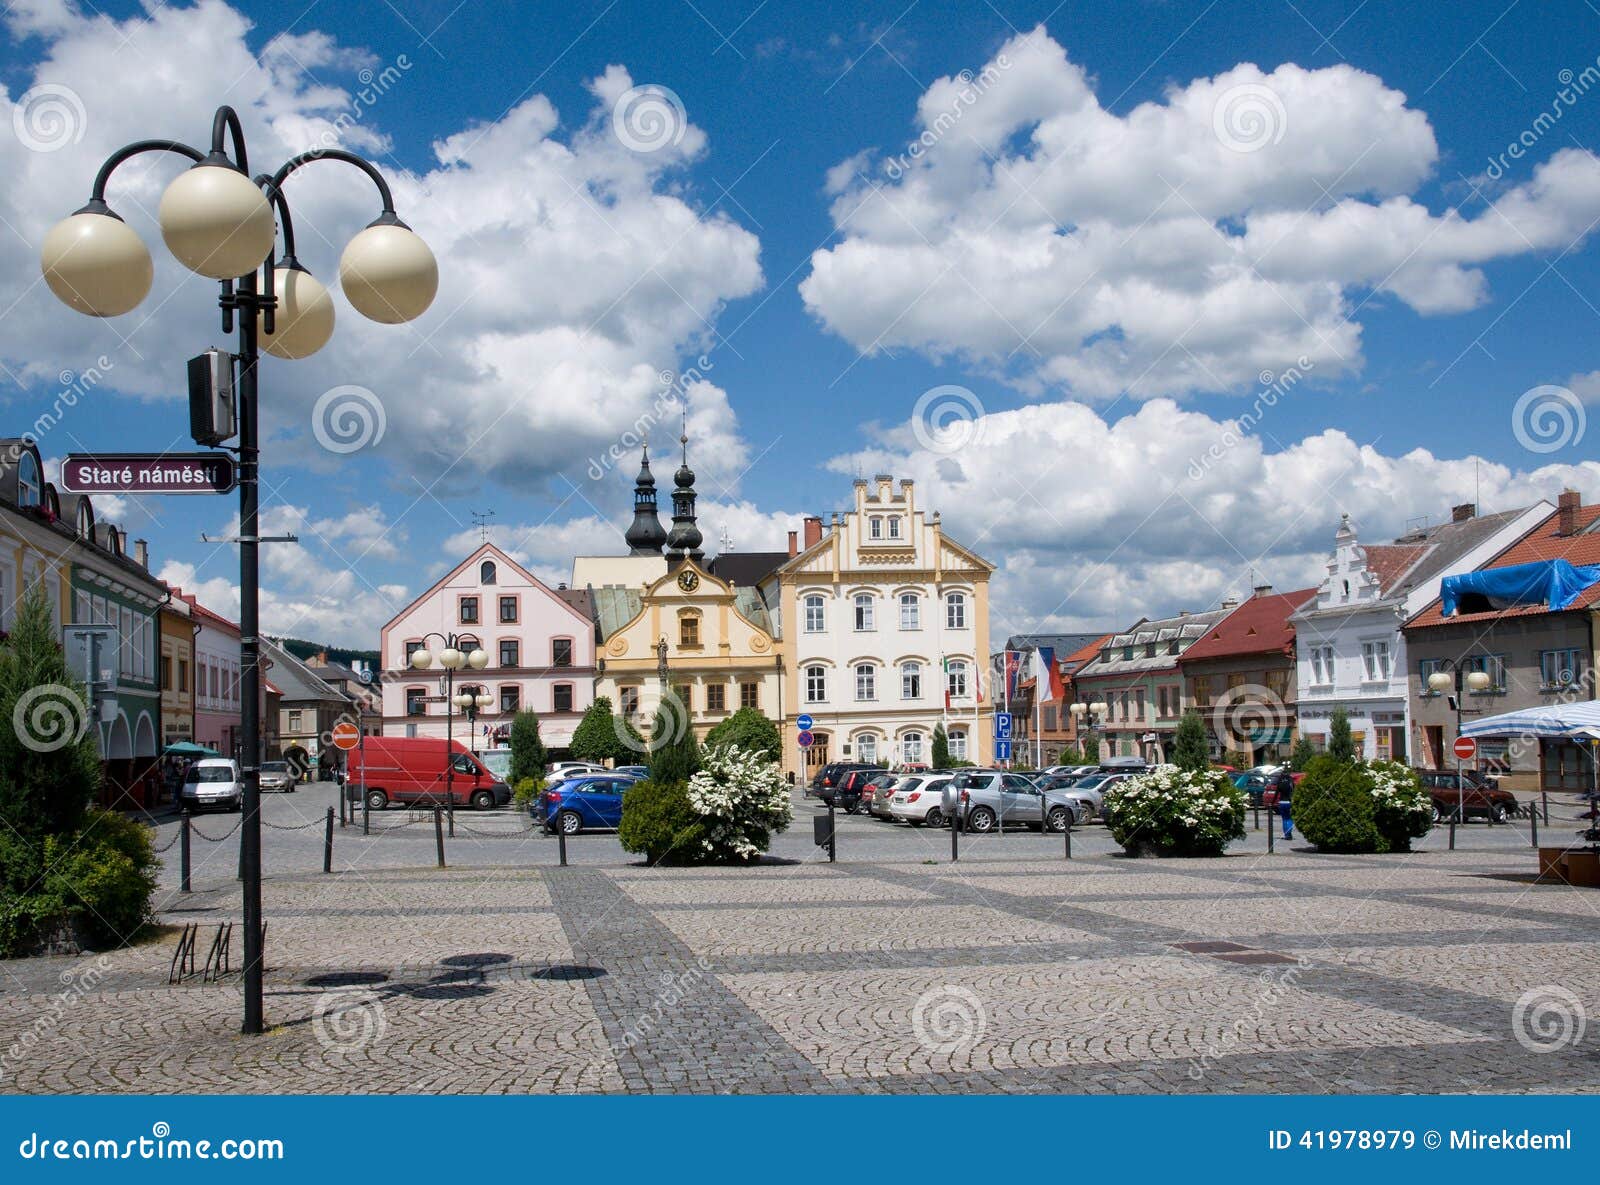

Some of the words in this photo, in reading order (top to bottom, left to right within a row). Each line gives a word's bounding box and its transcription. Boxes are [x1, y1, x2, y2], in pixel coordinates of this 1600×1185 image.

[79, 466, 133, 484] Staré
[139, 466, 218, 484] náměstí
[999, 716, 1009, 731] P
